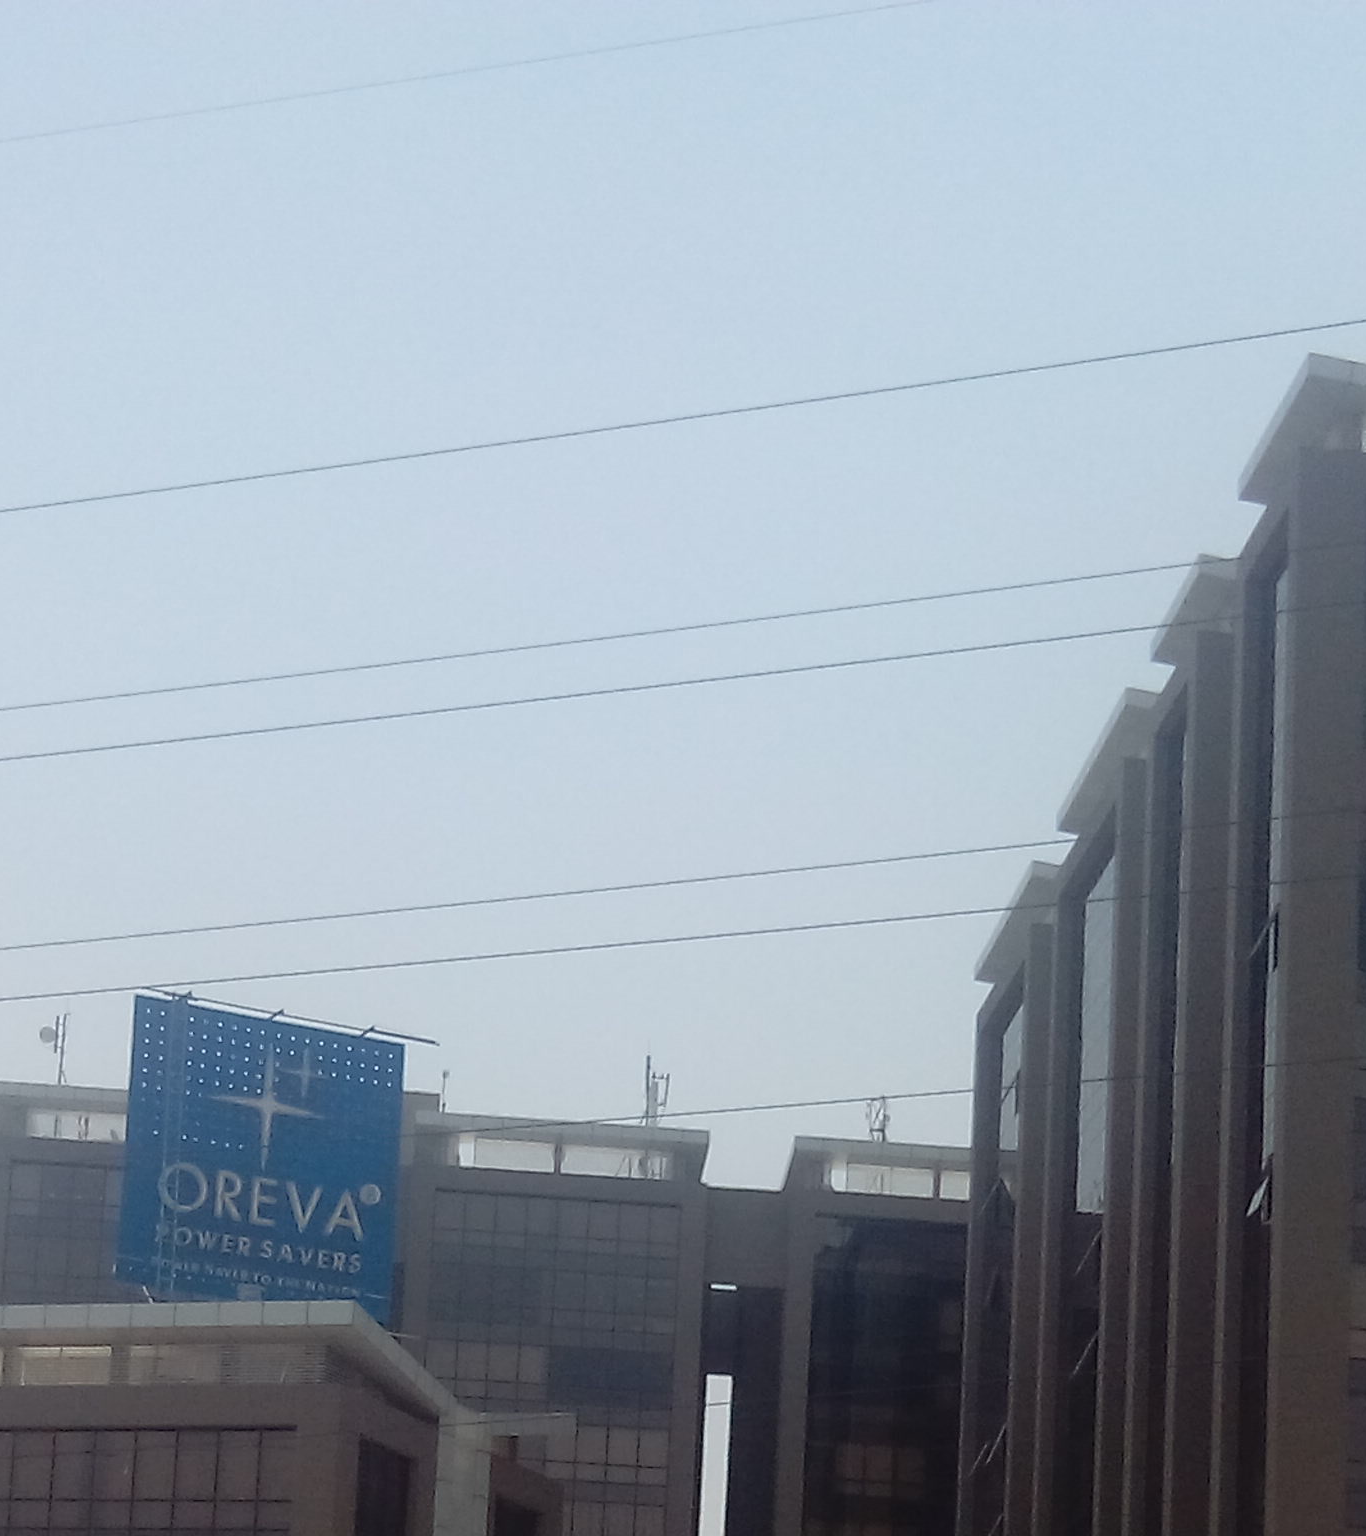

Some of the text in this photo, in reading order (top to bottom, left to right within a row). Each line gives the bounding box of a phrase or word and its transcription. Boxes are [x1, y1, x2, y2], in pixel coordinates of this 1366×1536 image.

[157, 1162, 364, 1241] OREVA
[155, 1224, 363, 1274] POWER SAVERS
